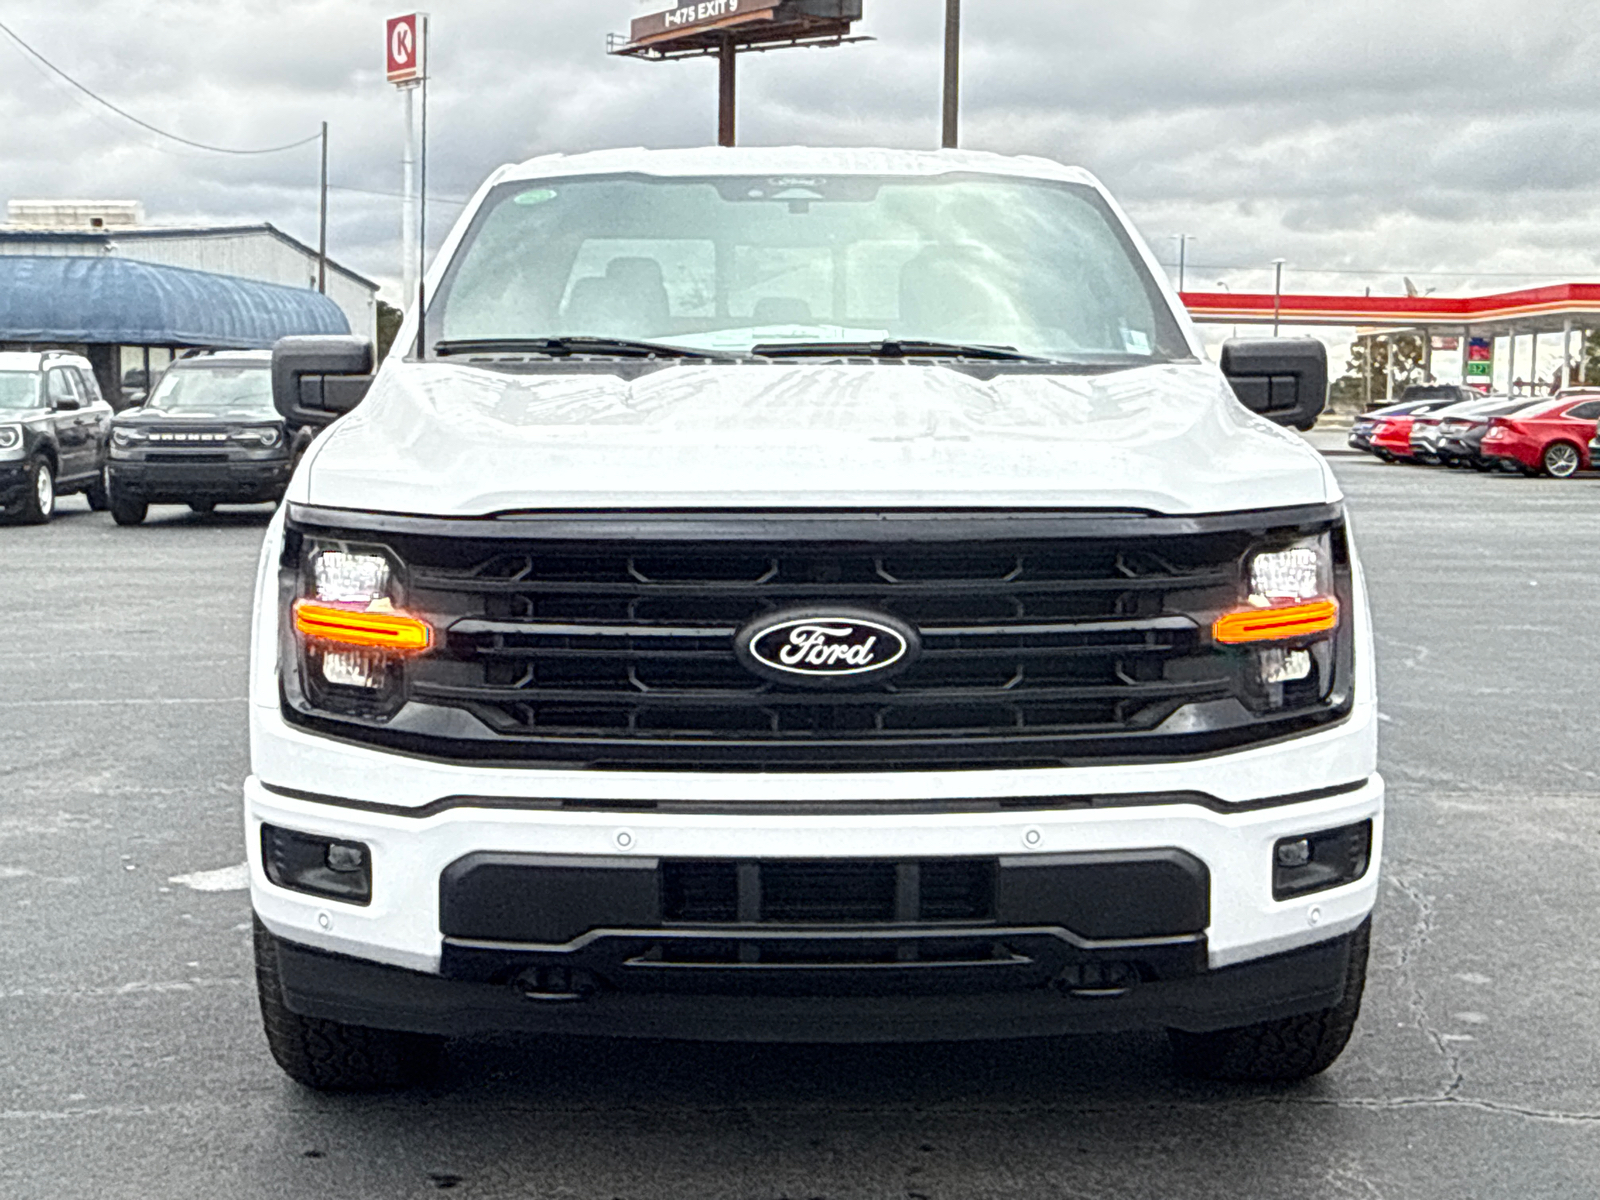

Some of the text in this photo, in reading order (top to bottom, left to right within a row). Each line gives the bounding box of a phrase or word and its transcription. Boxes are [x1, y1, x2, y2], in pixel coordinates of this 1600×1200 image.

[665, 6, 695, 27] I-475
[698, 0, 726, 19] EXIT
[779, 625, 876, 665] Ford
